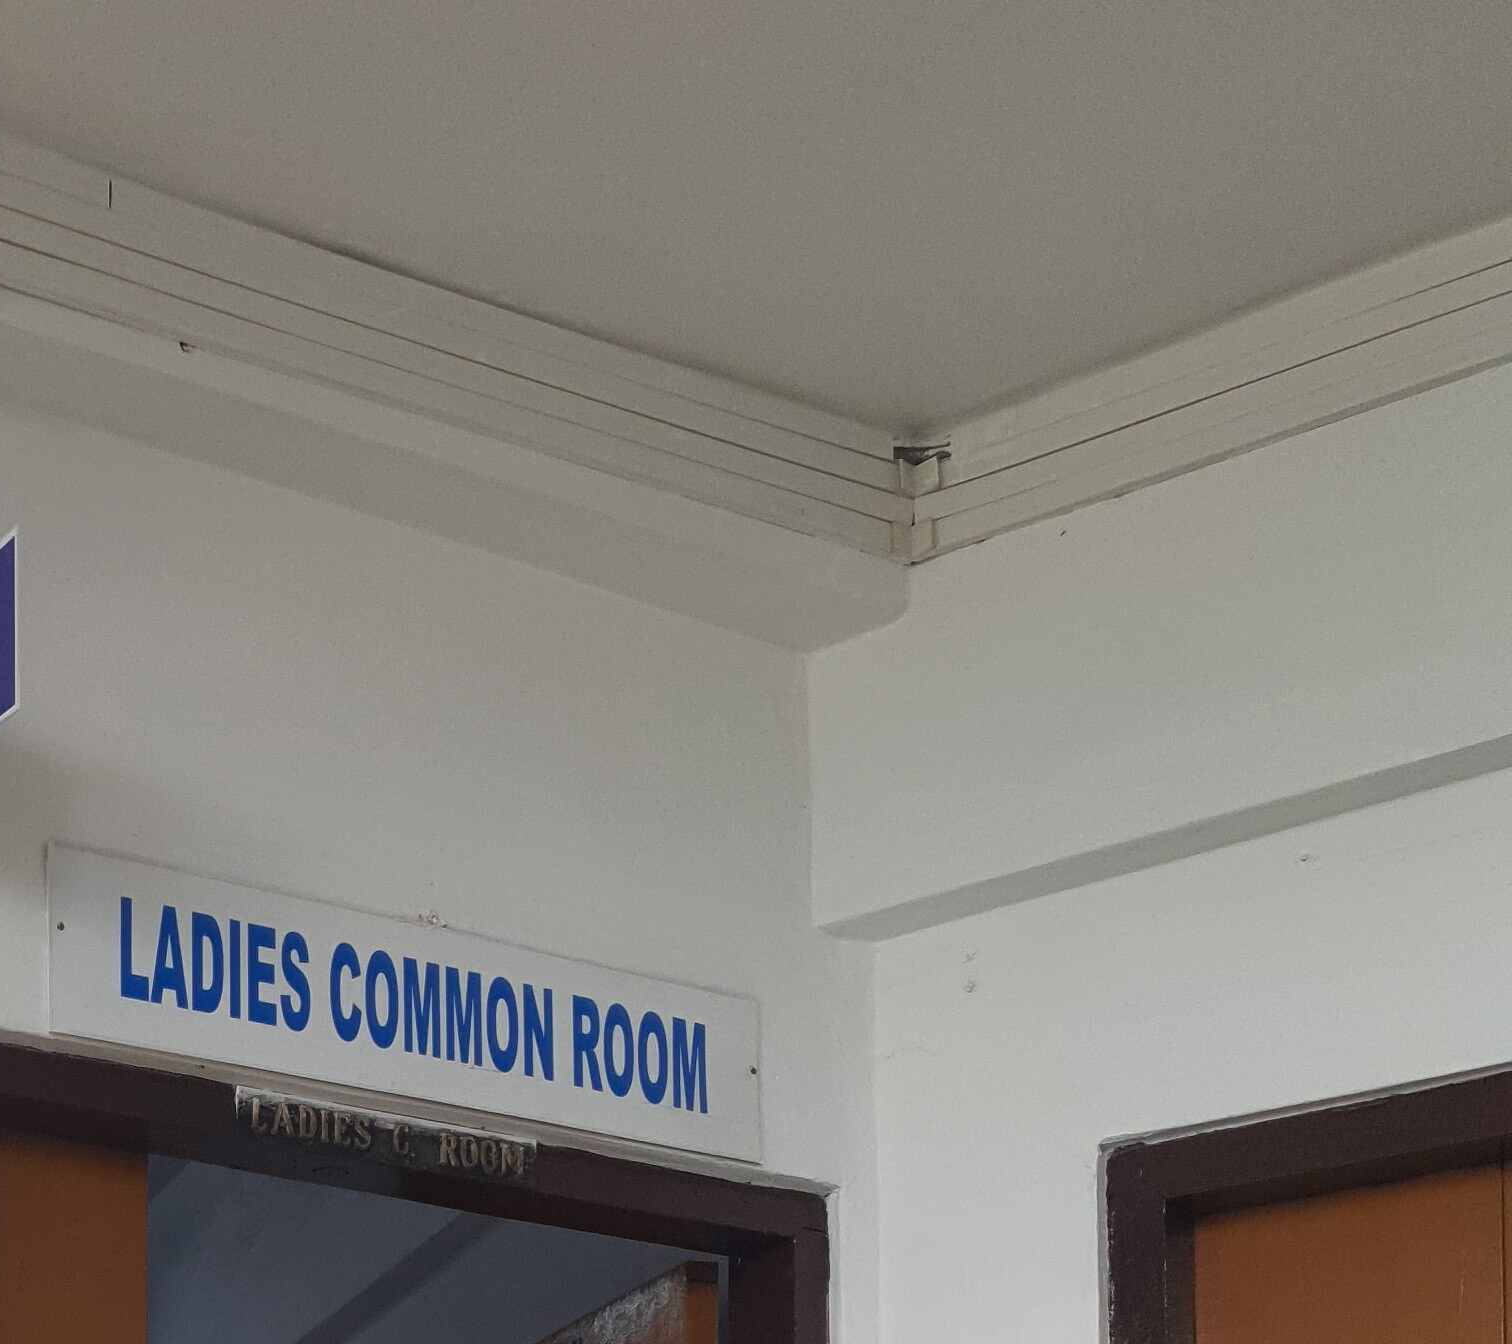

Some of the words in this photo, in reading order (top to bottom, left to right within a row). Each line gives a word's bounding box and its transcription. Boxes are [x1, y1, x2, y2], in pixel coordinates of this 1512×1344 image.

[118, 896, 310, 1032] LADIES
[329, 942, 555, 1081] COMMON
[571, 995, 708, 1114] ROOM
[250, 1097, 373, 1149] LADIES
[438, 1129, 525, 1178] ROOM
